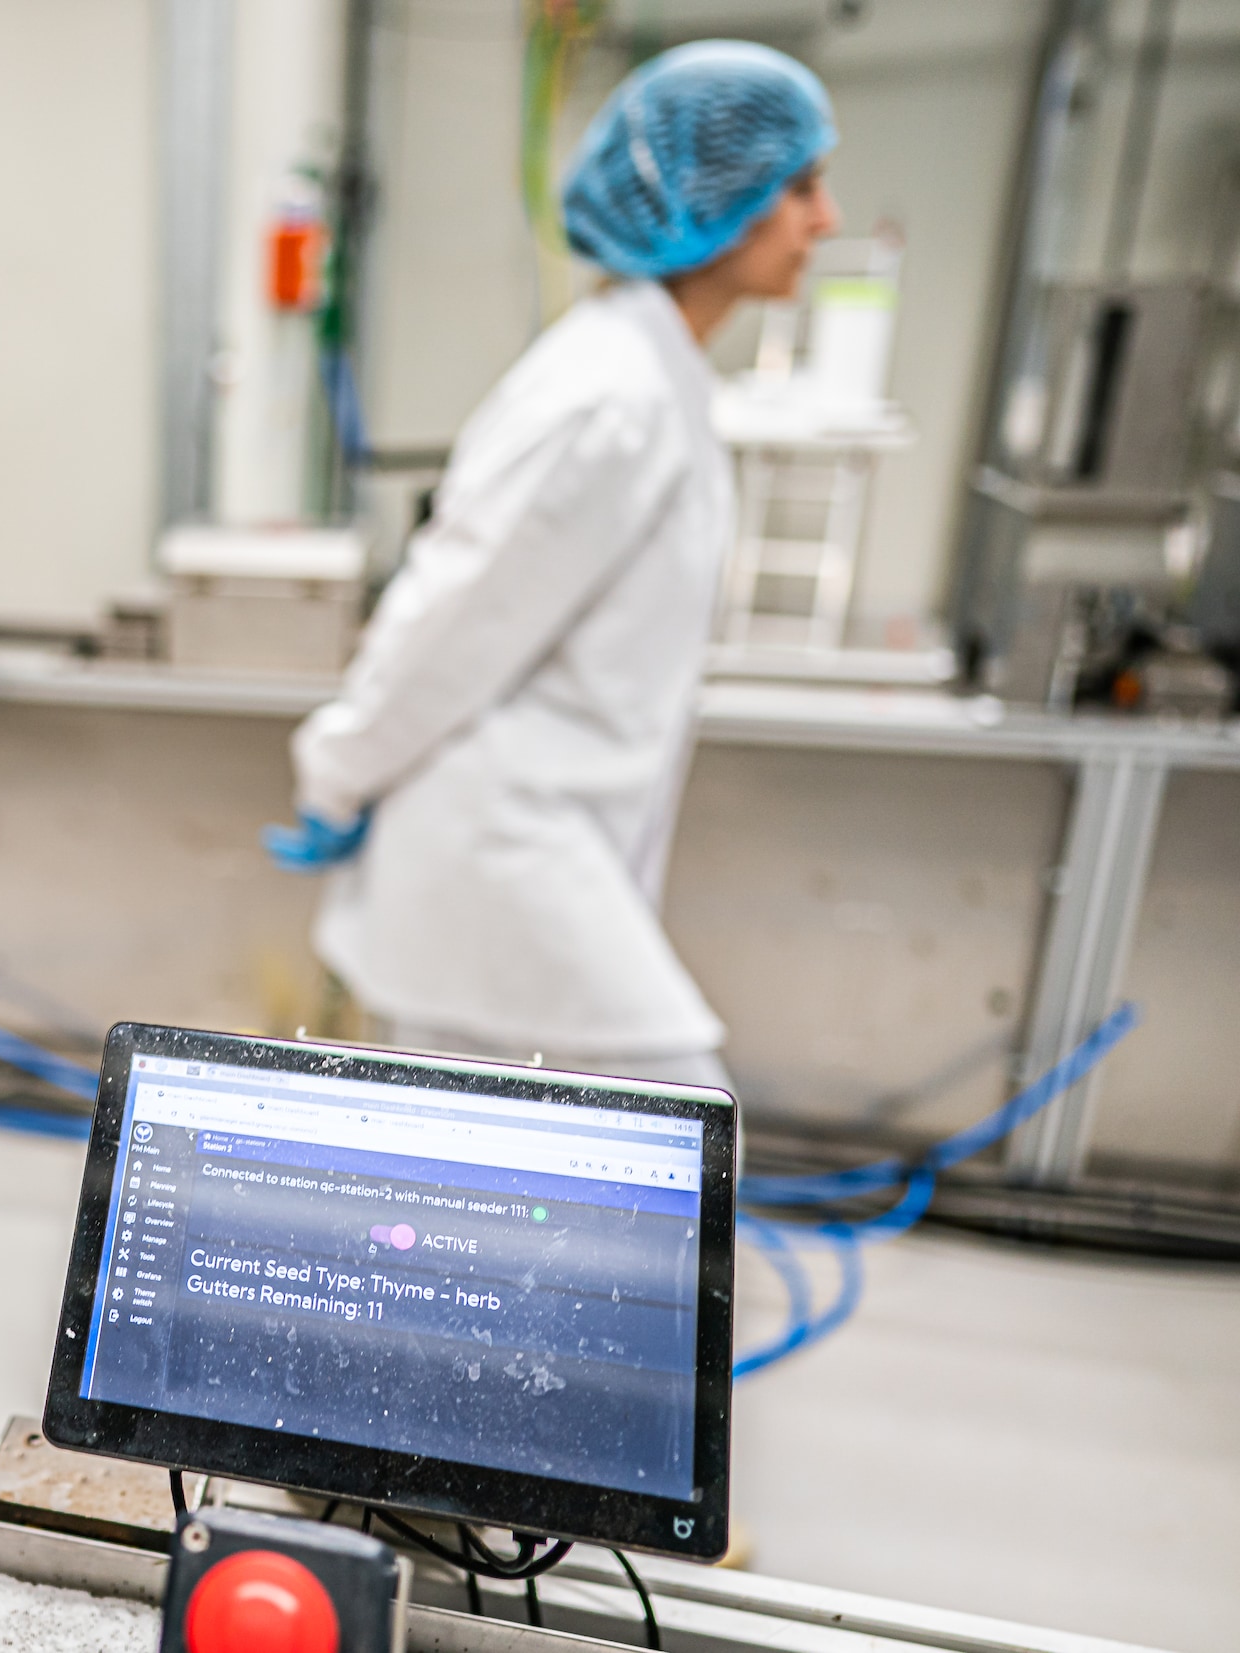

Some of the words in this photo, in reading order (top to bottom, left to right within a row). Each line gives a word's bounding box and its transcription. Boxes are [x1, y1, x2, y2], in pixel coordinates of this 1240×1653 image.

[131, 1144, 142, 1152] PM
[144, 1146, 160, 1155] Main
[203, 1141, 226, 1152] Station
[152, 1164, 171, 1173] Home
[150, 1181, 176, 1193] Planning
[202, 1164, 263, 1182] Connected
[266, 1172, 278, 1184] to
[280, 1174, 318, 1190] station
[320, 1181, 392, 1200] qc-station-2
[395, 1190, 420, 1203] with
[422, 1194, 465, 1210] manual
[468, 1201, 508, 1216] seeder
[147, 1198, 174, 1210] Lifecycle
[144, 1216, 174, 1228] Overview
[142, 1234, 167, 1246] Manage
[422, 1234, 478, 1254] ACTIVE
[140, 1252, 156, 1262] Tools
[136, 1270, 162, 1282] Grafana
[190, 1249, 260, 1275] Current
[264, 1260, 310, 1282] Seed
[316, 1267, 366, 1292] Type:
[371, 1275, 435, 1301] Thyme
[456, 1287, 501, 1310] herb
[134, 1288, 156, 1298] Theme
[187, 1275, 256, 1300] Gutters
[260, 1285, 362, 1321] Remaining:
[367, 1302, 383, 1320] 11
[132, 1298, 152, 1307] switch
[130, 1314, 152, 1325] Logout
